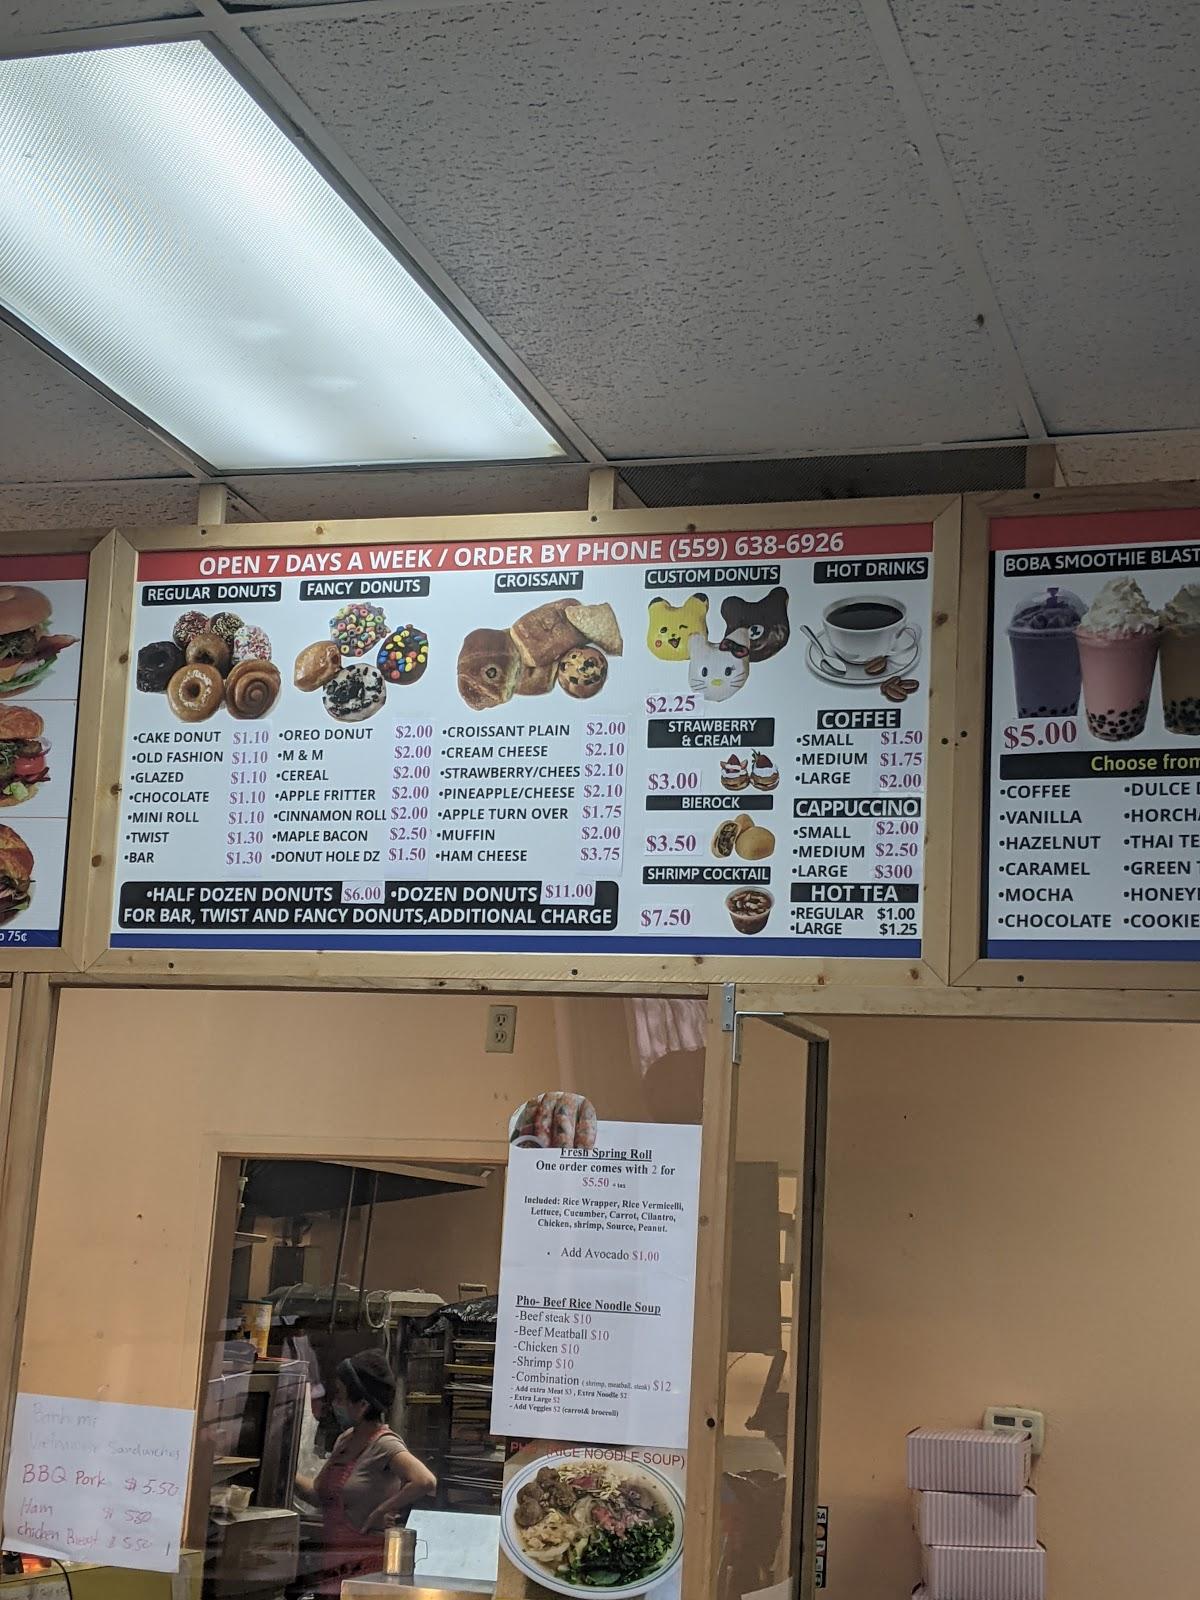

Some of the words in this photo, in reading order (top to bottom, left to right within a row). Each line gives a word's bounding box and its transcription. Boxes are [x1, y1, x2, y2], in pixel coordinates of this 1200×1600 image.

[200, 556, 260, 575] OPEN
[267, 555, 280, 573] 7
[286, 553, 342, 572] DAYS
[347, 552, 363, 570] A
[370, 549, 432, 569] WEEK
[438, 549, 448, 567] /
[455, 546, 533, 566] ORDER
[541, 544, 571, 563] BY
[578, 540, 662, 562] PHONE
[670, 538, 727, 562] (559)
[735, 532, 843, 555] 638-6926
[1006, 556, 1051, 571] BOBA
[1055, 551, 1146, 569] SMOOTHIE
[648, 569, 711, 585] CUSTOM
[714, 567, 778, 582] DONUTS
[827, 563, 862, 577] HOT
[866, 561, 925, 576] DRINKS
[497, 571, 579, 588] CROISSANT
[148, 587, 210, 600] REGULAR
[218, 585, 276, 598] DONUTS
[307, 582, 353, 595] FANCY
[360, 579, 420, 594] DONUTS
[647, 695, 695, 714] $2.25
[668, 720, 757, 732] STRAWBERRY
[822, 711, 897, 728] COFFEE
[325, 728, 373, 740] DONUT
[396, 725, 432, 739] $2.00
[529, 725, 569, 736] PLAIN
[587, 722, 625, 736] $2.00
[1004, 721, 1077, 750] $5.00
[174, 732, 221, 742] DONUT
[233, 731, 269, 744] $1.10
[682, 735, 691, 746] &
[695, 734, 741, 746] CREAM
[881, 731, 922, 745] $1.50
[395, 745, 431, 759] $2.00
[498, 746, 548, 757] CHEESE
[586, 743, 624, 756] $2.10
[167, 752, 223, 762] FASHION
[232, 751, 268, 764] $1.10
[880, 752, 922, 766] $1.75
[1091, 755, 1157, 771] Choose
[393, 766, 430, 779] $2.00
[585, 763, 623, 777] $2.10
[231, 771, 266, 784] $1.10
[649, 773, 697, 790] $3.00
[880, 774, 921, 787] $2.00
[230, 791, 265, 804] $1.10
[324, 789, 375, 800] FRITTER
[392, 786, 429, 799] $2.00
[584, 784, 622, 798] $2.10
[682, 796, 740, 809] BIEROCK
[795, 800, 919, 817] CAPPUCCINO
[167, 812, 199, 822] ROLL
[229, 811, 264, 824] $1.10
[356, 810, 386, 820] ROLL
[391, 807, 428, 820] $2.00
[488, 808, 526, 819] TURN
[532, 808, 568, 819] OVER
[583, 805, 621, 819] $1.75
[323, 830, 367, 841] BACON
[390, 827, 427, 840] $2.50
[582, 826, 621, 840] $2.00
[876, 821, 918, 835] $2.00
[227, 831, 263, 845] $1.30
[647, 835, 696, 852] $3.50
[325, 850, 360, 863] HOLE
[364, 851, 380, 861] DZ
[389, 848, 425, 861] $1.50
[478, 850, 527, 861] CHEESE
[581, 848, 620, 861] $3.75
[876, 843, 918, 857] $2.50
[227, 851, 262, 864] $1.30
[648, 868, 699, 879] SHRIMP
[703, 867, 769, 881] COCKTAIL
[875, 865, 912, 879] $300
[200, 887, 256, 902] DOZEN
[262, 887, 333, 901] DONUTS
[344, 886, 381, 902] $6.00
[463, 887, 537, 902] DONUTS
[546, 884, 592, 898] $11.00
[812, 885, 855, 901] HOT
[860, 886, 898, 901] TEA
[124, 908, 155, 922] FOR
[160, 908, 195, 924] BAR,
[200, 908, 249, 922] TWIST
[252, 908, 289, 922] AND
[294, 908, 348, 922] FANCY
[541, 909, 612, 924] CHARGE
[641, 909, 690, 927] $7.50
[877, 907, 915, 920] $1.00
[880, 923, 917, 936] $1.25
[592, 1148, 626, 1161] Spring
[630, 1149, 652, 1162] Roll
[536, 1160, 556, 1170] One
[559, 1162, 587, 1171] order
[591, 1165, 622, 1173] comes
[625, 1164, 648, 1174] with
[652, 1165, 657, 1174] 2
[661, 1165, 675, 1175] for
[583, 1177, 609, 1187] $5.50
[582, 1198, 619, 1209] Wrapper,
[622, 1200, 639, 1208] Rice
[531, 1207, 561, 1217] Lettuce,
[564, 1209, 607, 1219] Cucumber,
[609, 1211, 639, 1221] Carrot,
[538, 1219, 572, 1228] Chicken,
[561, 1247, 581, 1258] Add
[585, 1248, 629, 1260] Avocado
[515, 1295, 540, 1309] Pho-
[543, 1297, 566, 1310] Beef
[570, 1298, 591, 1309] Rice
[595, 1300, 631, 1311] Noodle
[635, 1301, 661, 1315] Soup
[545, 1313, 570, 1323] steak
[574, 1314, 591, 1324] $10
[544, 1327, 587, 1339] Meatball
[591, 1329, 609, 1341] $10
[561, 1344, 579, 1354] $10
[556, 1359, 574, 1369] $10
[653, 1380, 671, 1392] $12
